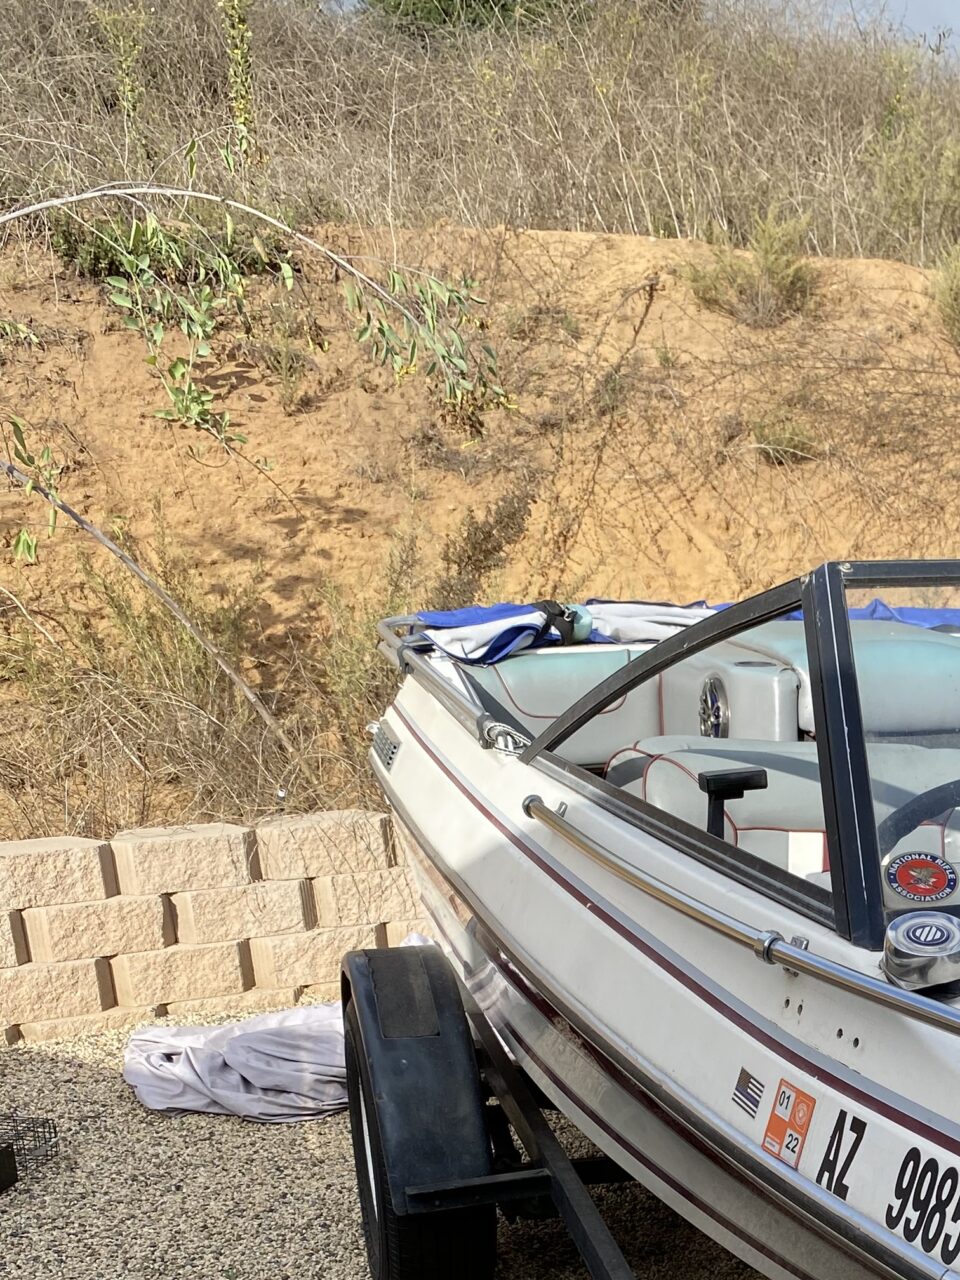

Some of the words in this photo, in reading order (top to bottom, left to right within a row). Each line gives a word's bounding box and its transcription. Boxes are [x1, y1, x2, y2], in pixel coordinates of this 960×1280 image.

[889, 853, 933, 874] NATIONAL
[935, 857, 956, 880] RIFLE
[891, 882, 952, 902] ASSOCIATION
[778, 1090, 792, 1111] 01
[785, 1133, 800, 1155] 22
[815, 1109, 867, 1202] AZ
